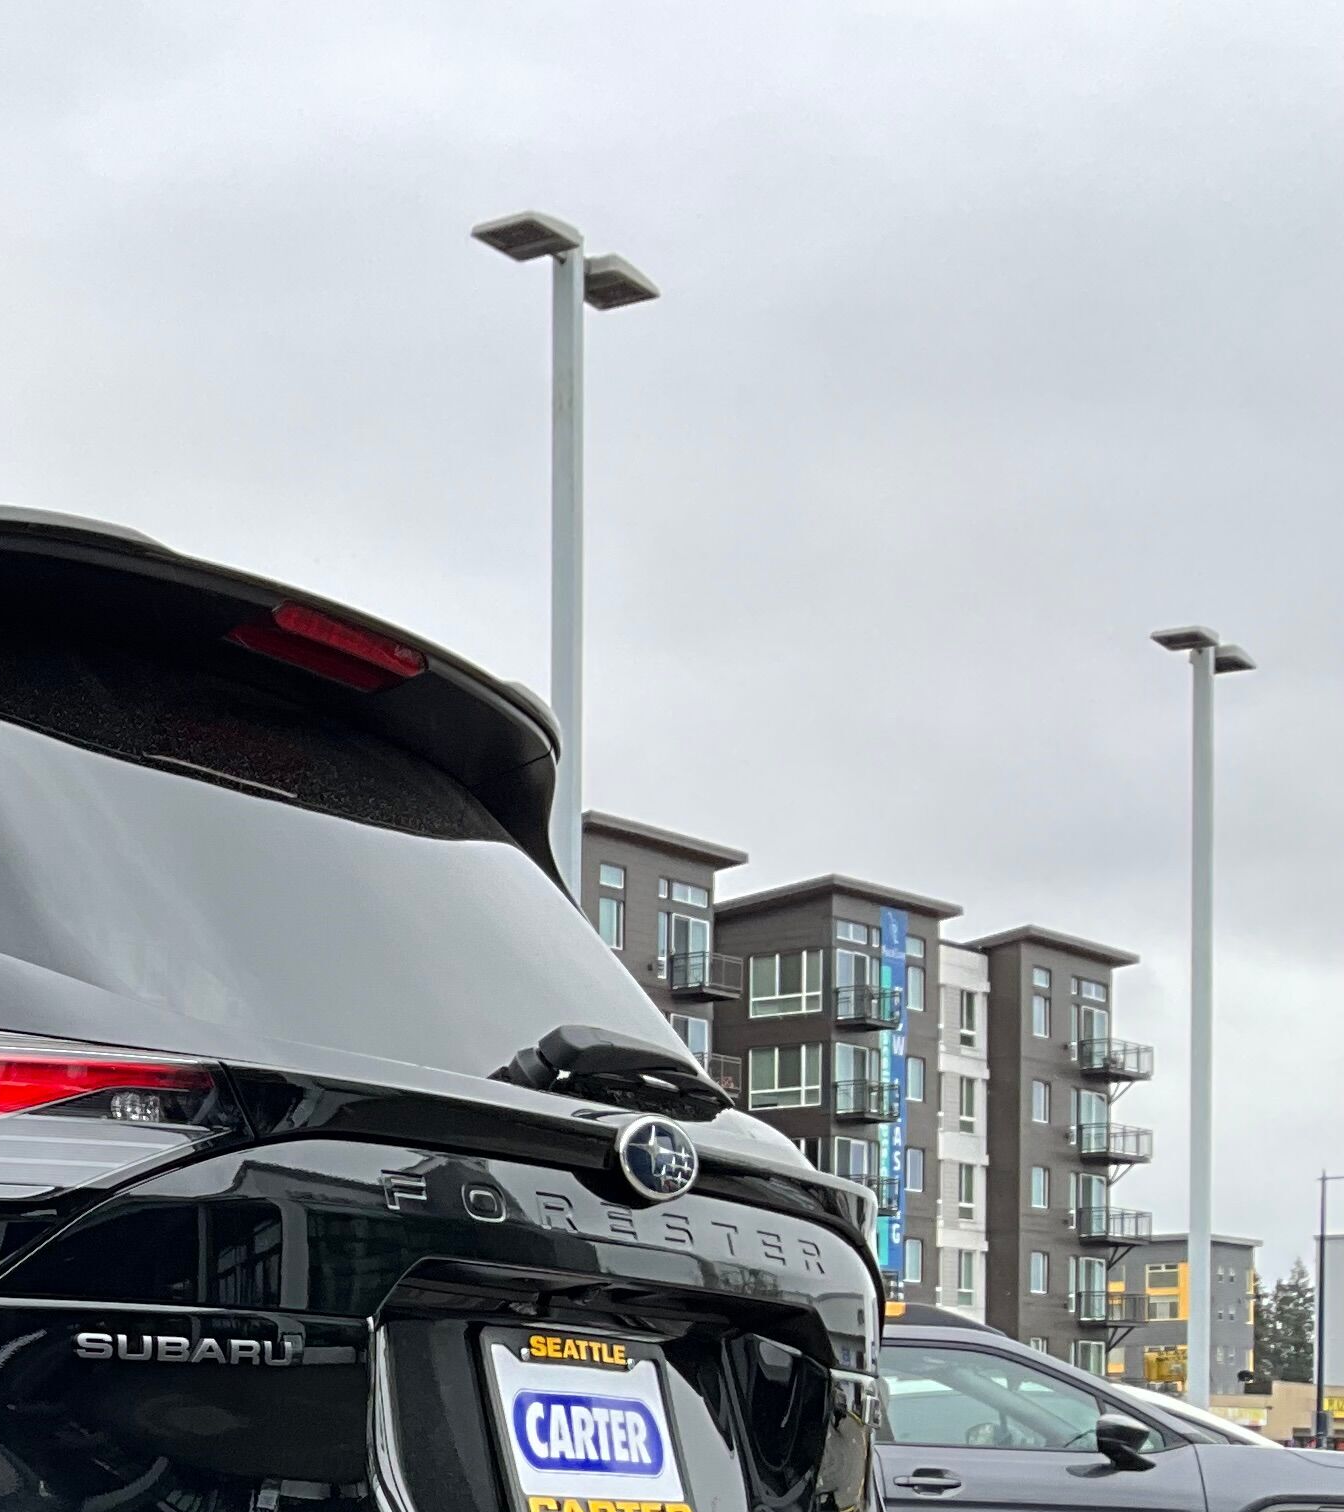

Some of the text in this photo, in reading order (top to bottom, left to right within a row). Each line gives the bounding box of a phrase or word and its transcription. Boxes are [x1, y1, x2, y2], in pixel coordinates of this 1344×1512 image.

[381, 1168, 826, 1276] FORESTER
[75, 1331, 294, 1366] SUBARU
[529, 1334, 627, 1366] SEATTLE
[525, 1400, 652, 1465] CARTER
